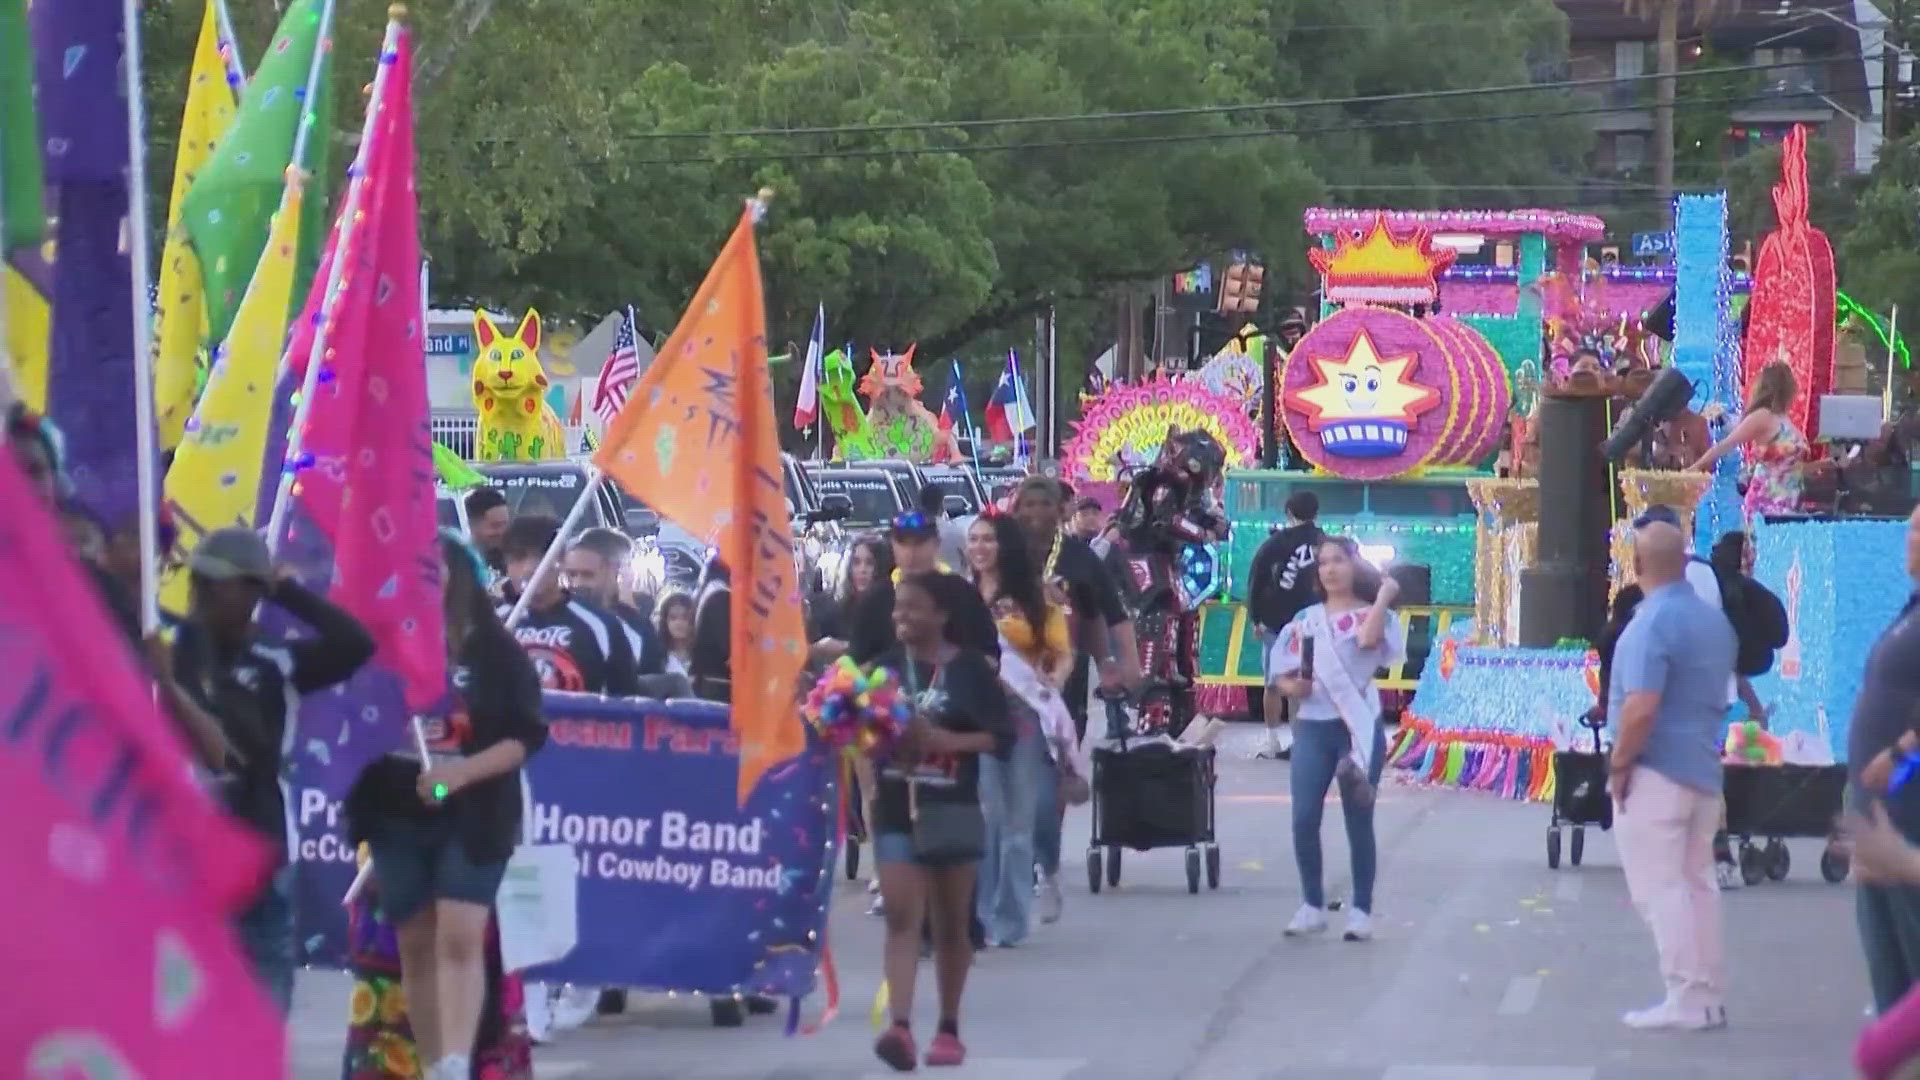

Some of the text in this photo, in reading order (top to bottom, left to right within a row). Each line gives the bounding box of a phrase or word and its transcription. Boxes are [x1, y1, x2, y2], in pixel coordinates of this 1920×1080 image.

[425, 335, 453, 352] and
[549, 715, 741, 755] eau Para
[300, 787, 763, 856] Pr Honor Band
[597, 851, 704, 893] Cowboy
[709, 859, 784, 890] Band
